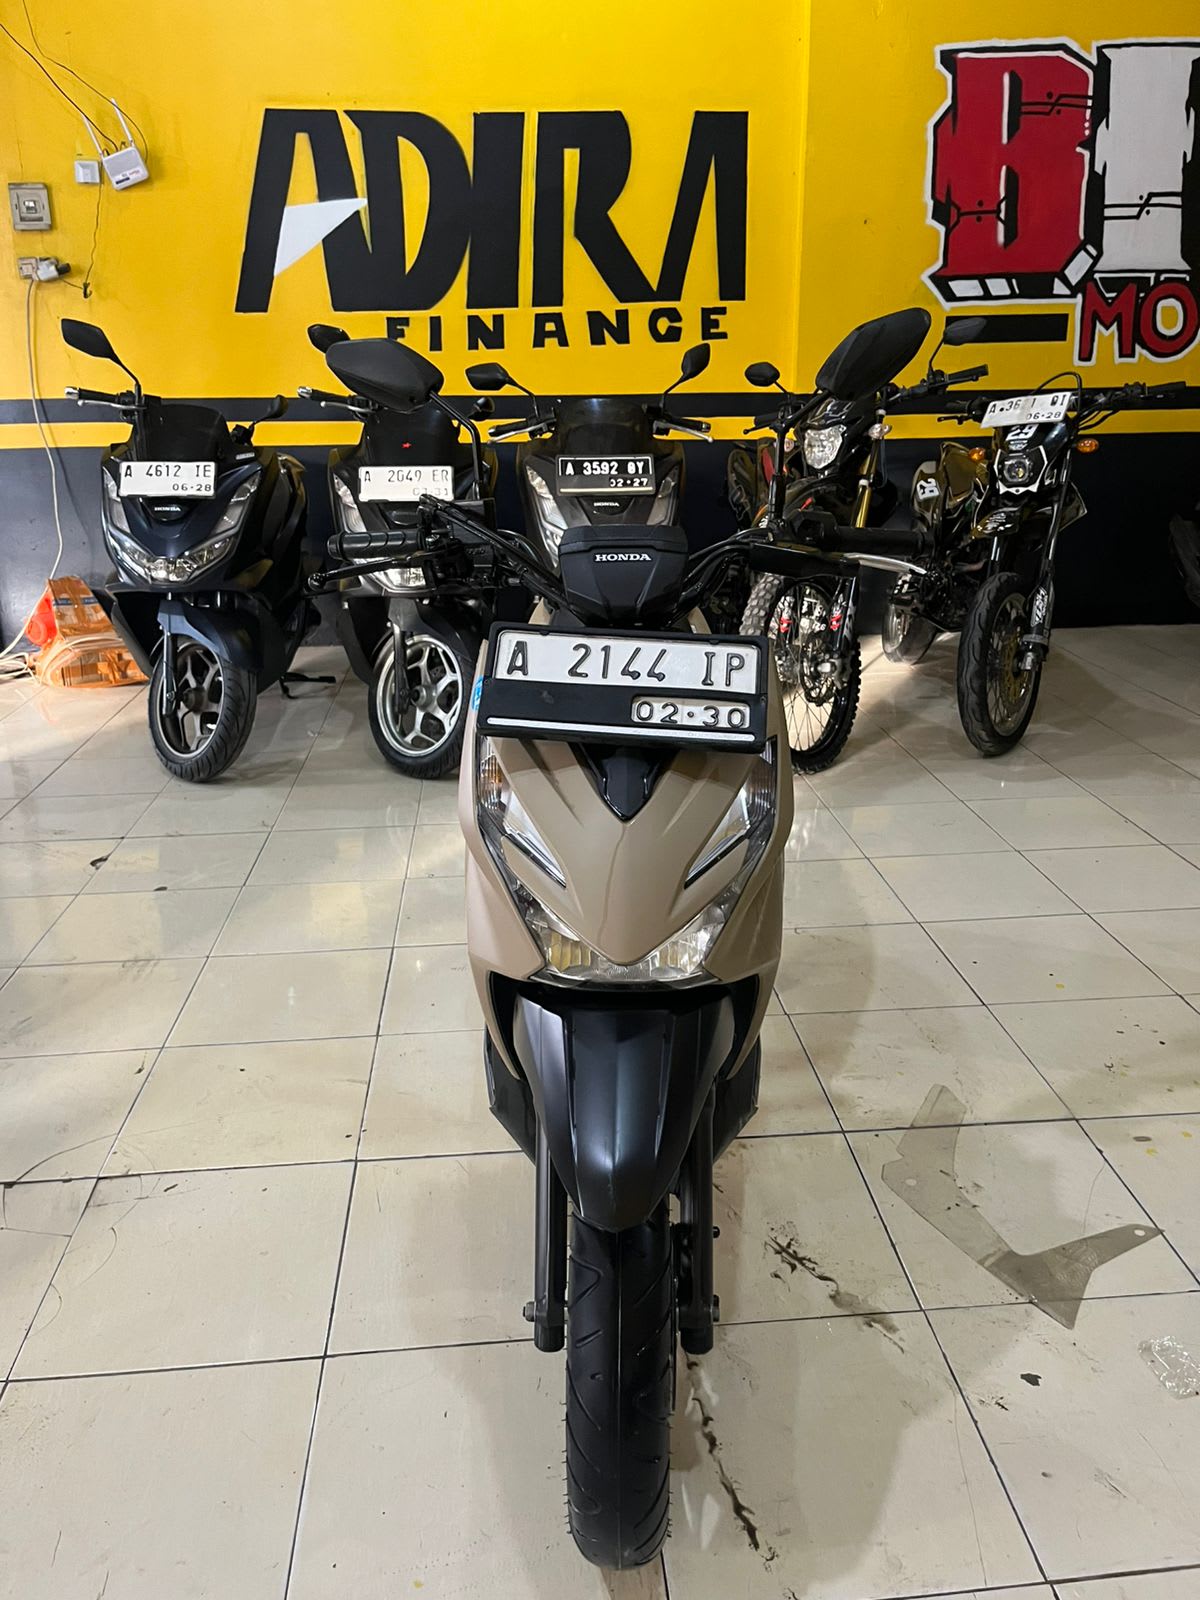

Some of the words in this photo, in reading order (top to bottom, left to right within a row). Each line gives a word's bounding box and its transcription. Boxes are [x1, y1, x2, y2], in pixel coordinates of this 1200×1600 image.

[235, 108, 749, 313] ADIRA
[386, 306, 728, 351] FINANCE
[989, 403, 997, 414] A
[124, 465, 132, 477] A
[146, 465, 181, 477] 4612
[196, 465, 211, 477] IE
[566, 462, 575, 475] A
[583, 461, 618, 475] 3592
[364, 470, 371, 482] A
[388, 469, 422, 482] 2049
[432, 469, 449, 481] ER
[595, 553, 651, 561] HONDA
[507, 641, 528, 676] A
[567, 643, 667, 682] 2144
[701, 651, 745, 687] IP
